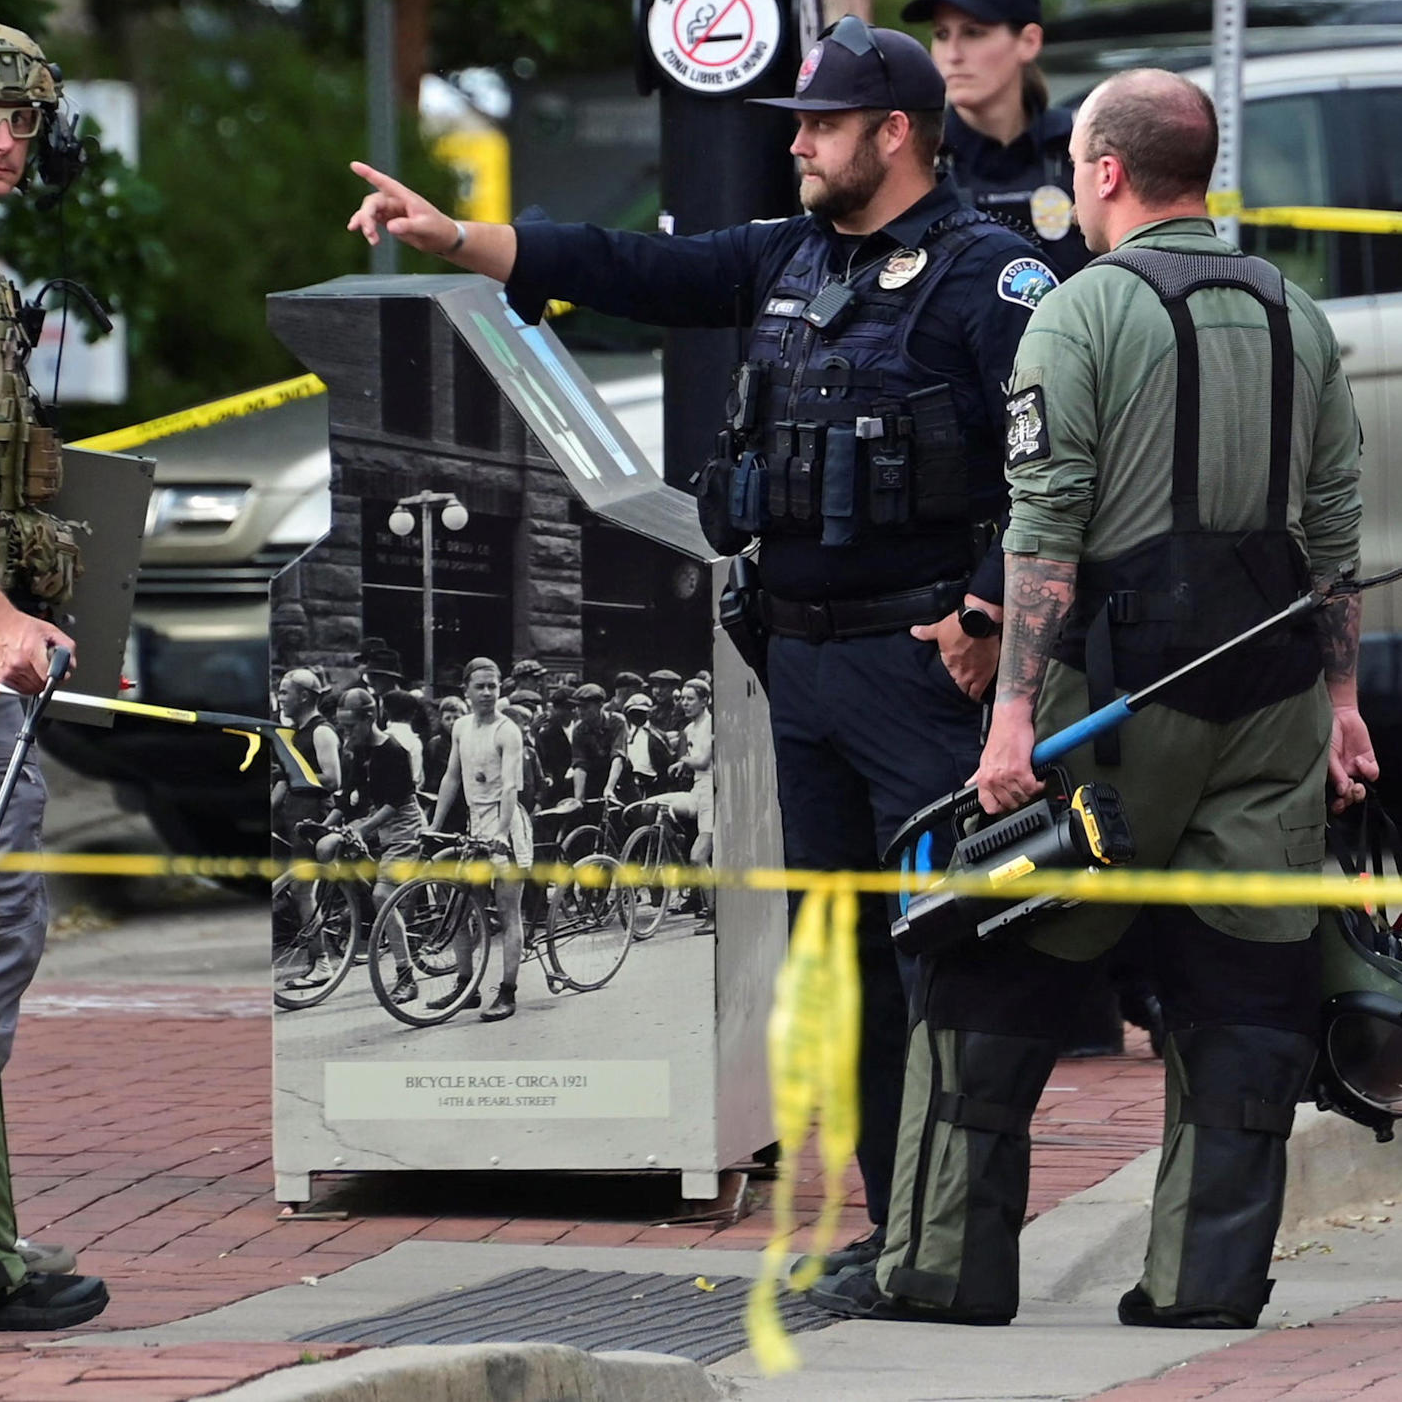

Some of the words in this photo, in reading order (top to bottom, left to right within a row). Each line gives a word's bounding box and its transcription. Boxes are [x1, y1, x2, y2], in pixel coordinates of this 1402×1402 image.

[662, 47, 689, 77] ZONA
[689, 69, 723, 85] LIBRE
[725, 68, 742, 83] DE
[743, 40, 768, 74] HUMO
[1003, 261, 1051, 284] BOULDER
[405, 1076, 465, 1088] BICYCLE
[468, 1076, 506, 1088] RACE
[515, 1075, 559, 1088] CIRCA
[562, 1075, 588, 1088] 1921
[438, 1097, 464, 1107] 14TH
[466, 1097, 476, 1107] &
[477, 1097, 513, 1107] PEARL
[515, 1096, 557, 1107] STREET
